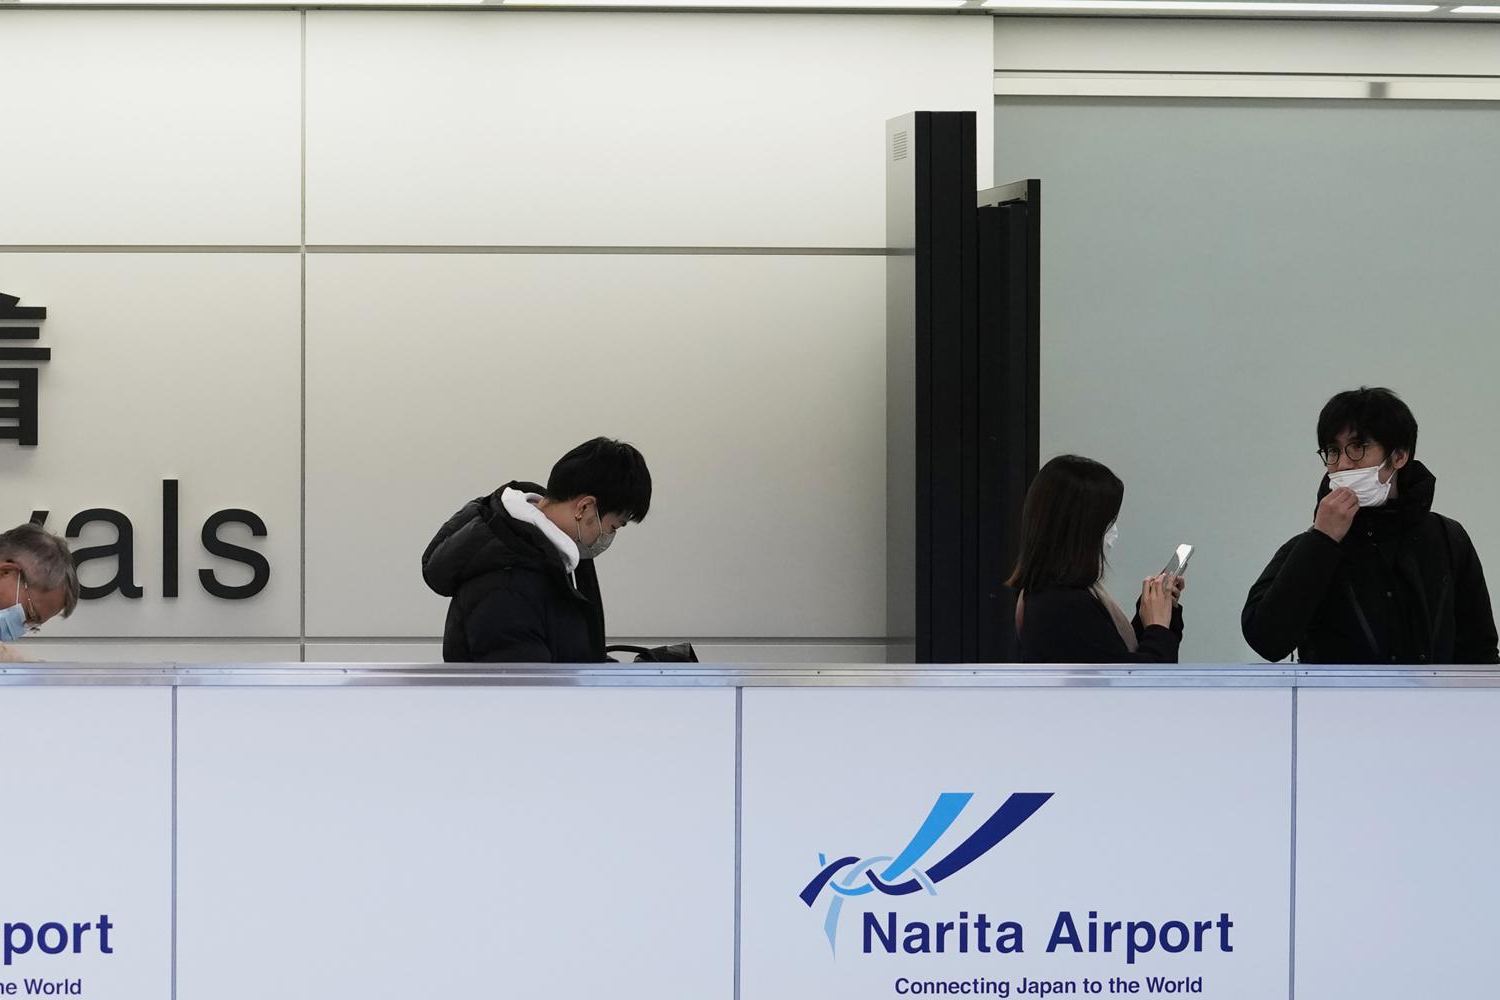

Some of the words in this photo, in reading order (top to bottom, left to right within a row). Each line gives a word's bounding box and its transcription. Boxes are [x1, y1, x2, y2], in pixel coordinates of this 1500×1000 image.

[862, 910, 1025, 955] Narita
[1045, 910, 1234, 965] Airport
[23, 978, 82, 996] World
[894, 976, 1011, 999] Connecting
[1016, 976, 1077, 999] Japan
[1081, 977, 1103, 994] to
[1107, 976, 1141, 994] the
[1145, 975, 1203, 994] World
